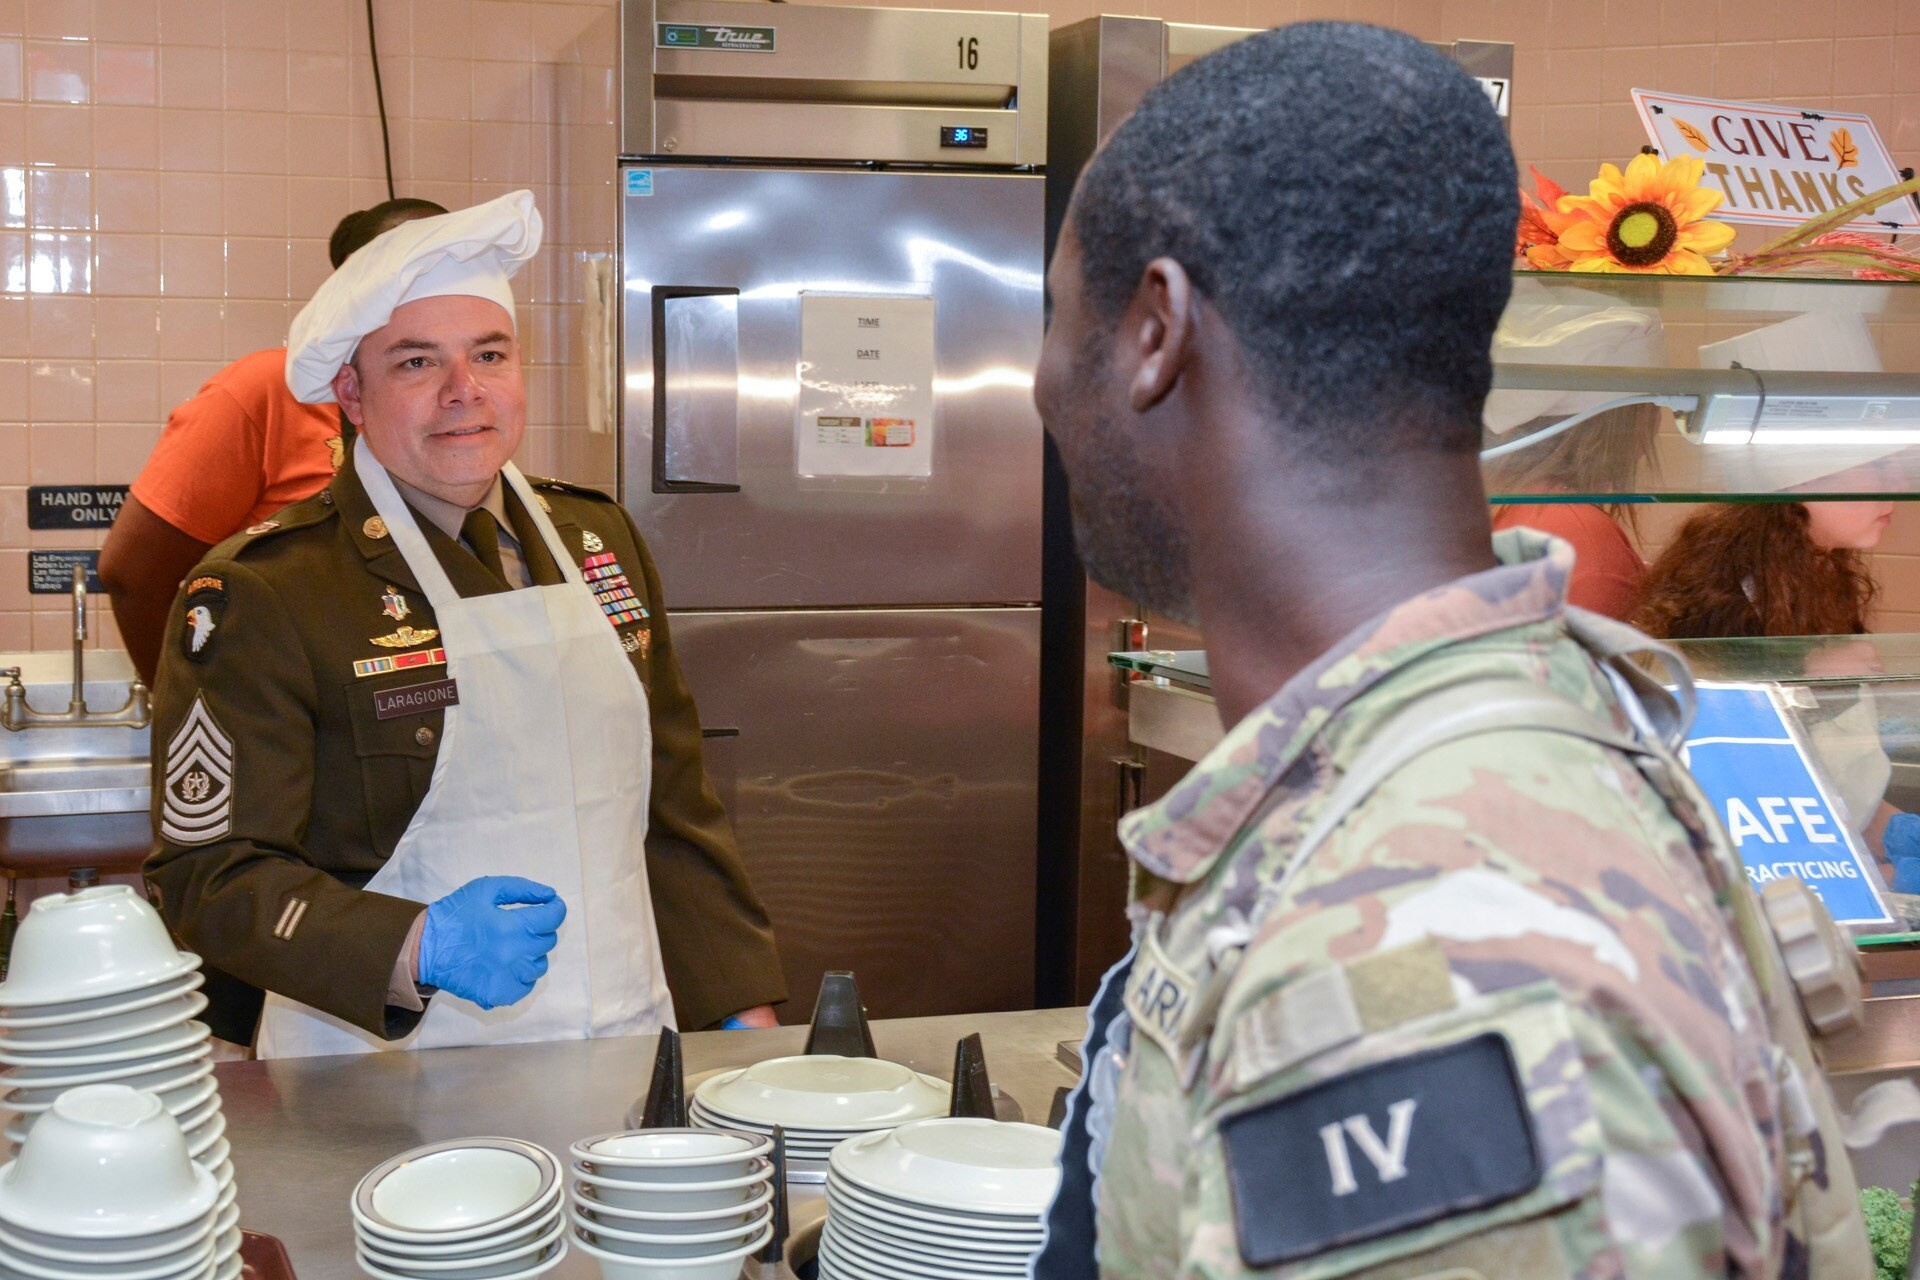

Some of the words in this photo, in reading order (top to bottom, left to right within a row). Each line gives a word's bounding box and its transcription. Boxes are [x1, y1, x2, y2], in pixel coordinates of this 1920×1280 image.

[957, 37, 979, 70] 16
[954, 128, 968, 141] 36
[1711, 115, 1829, 162] GIVE
[858, 317, 880, 327] TIME
[857, 349, 880, 359] DATE
[41, 492, 92, 505] HAND
[96, 492, 129, 505] WA
[71, 508, 118, 521] ONLY
[377, 686, 456, 711] LARAGIONE
[1726, 797, 1838, 847] AFE
[1744, 860, 1858, 883] RACTICING
[1319, 1098, 1418, 1197] IV
